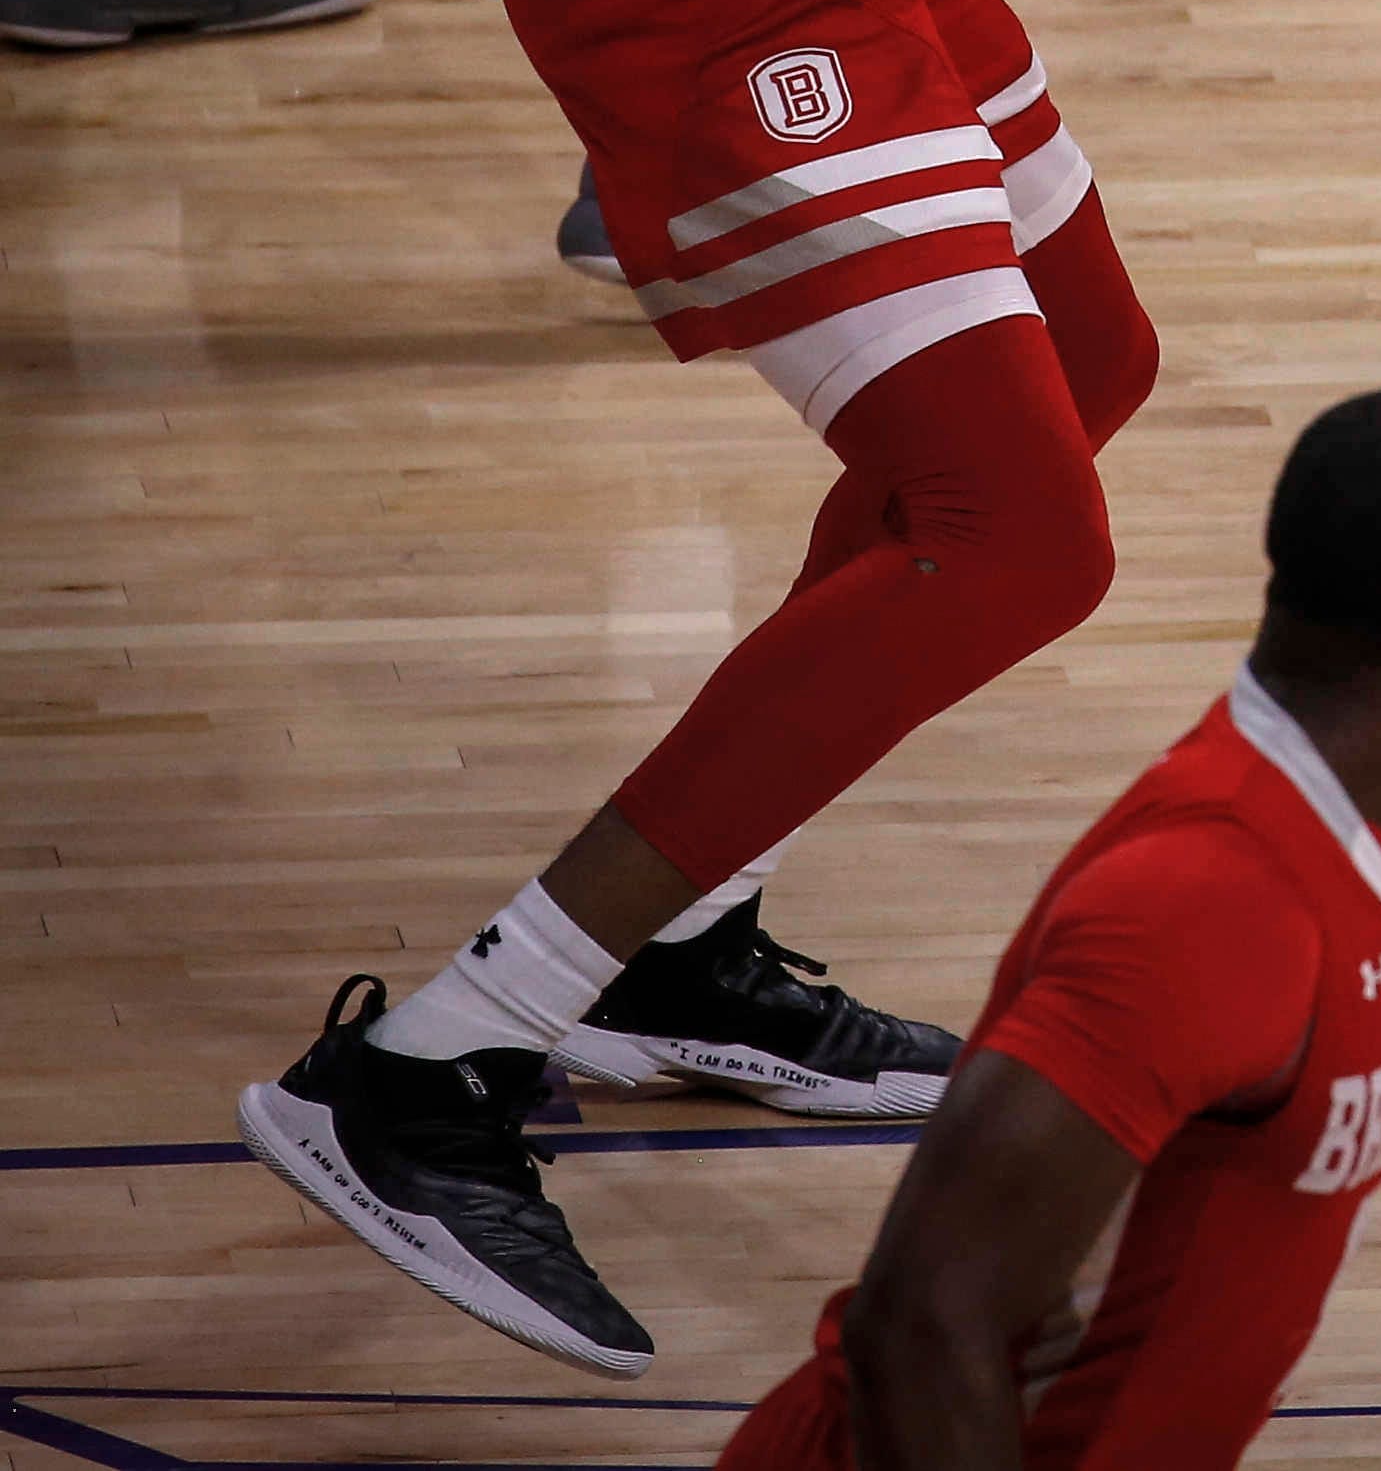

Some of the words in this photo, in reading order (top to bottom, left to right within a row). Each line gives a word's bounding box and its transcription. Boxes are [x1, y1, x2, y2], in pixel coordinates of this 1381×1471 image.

[768, 63, 831, 128] B
[696, 1054, 720, 1067] CAN
[726, 1058, 743, 1071] DO
[747, 1062, 766, 1076] ALL
[298, 1138, 310, 1149] A
[310, 1149, 334, 1172] MAN
